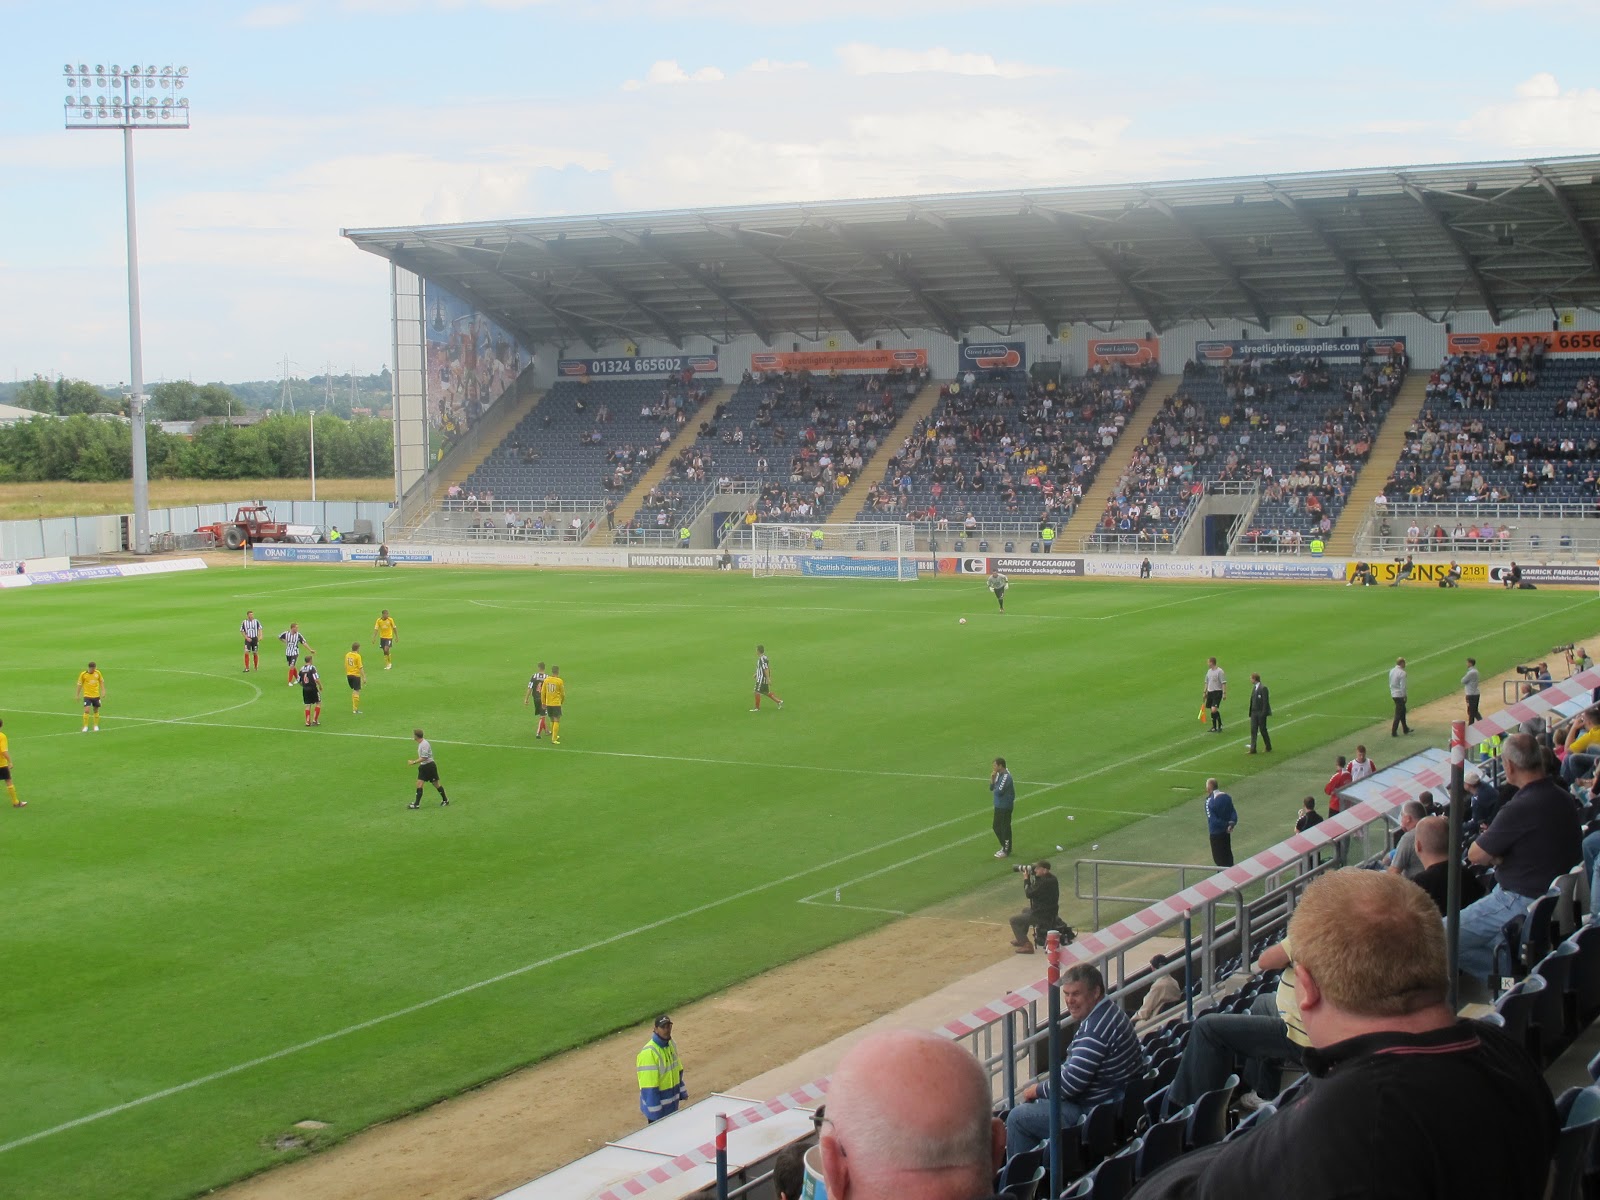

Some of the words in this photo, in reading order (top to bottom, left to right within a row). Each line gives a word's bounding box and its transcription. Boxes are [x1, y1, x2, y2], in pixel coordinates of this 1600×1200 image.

[983, 347, 1006, 355] Lighting
[1240, 343, 1360, 356] streetlightingsupplies.com
[787, 354, 888, 367] streetlightingsupplies.com
[592, 361, 631, 373] 01324
[634, 359, 681, 371] 665602
[631, 556, 713, 567] PUMAFOOTBALL.COM
[738, 555, 797, 563] CENTRAL
[997, 559, 1031, 567] CARRICK
[1032, 559, 1076, 567] PACKAGING
[997, 567, 1076, 575] www.carrickpackaging.com
[1101, 562, 1195, 572] www.jarvilant.co.uk
[547, 682, 556, 693] 10
[1504, 979, 1511, 988] K
